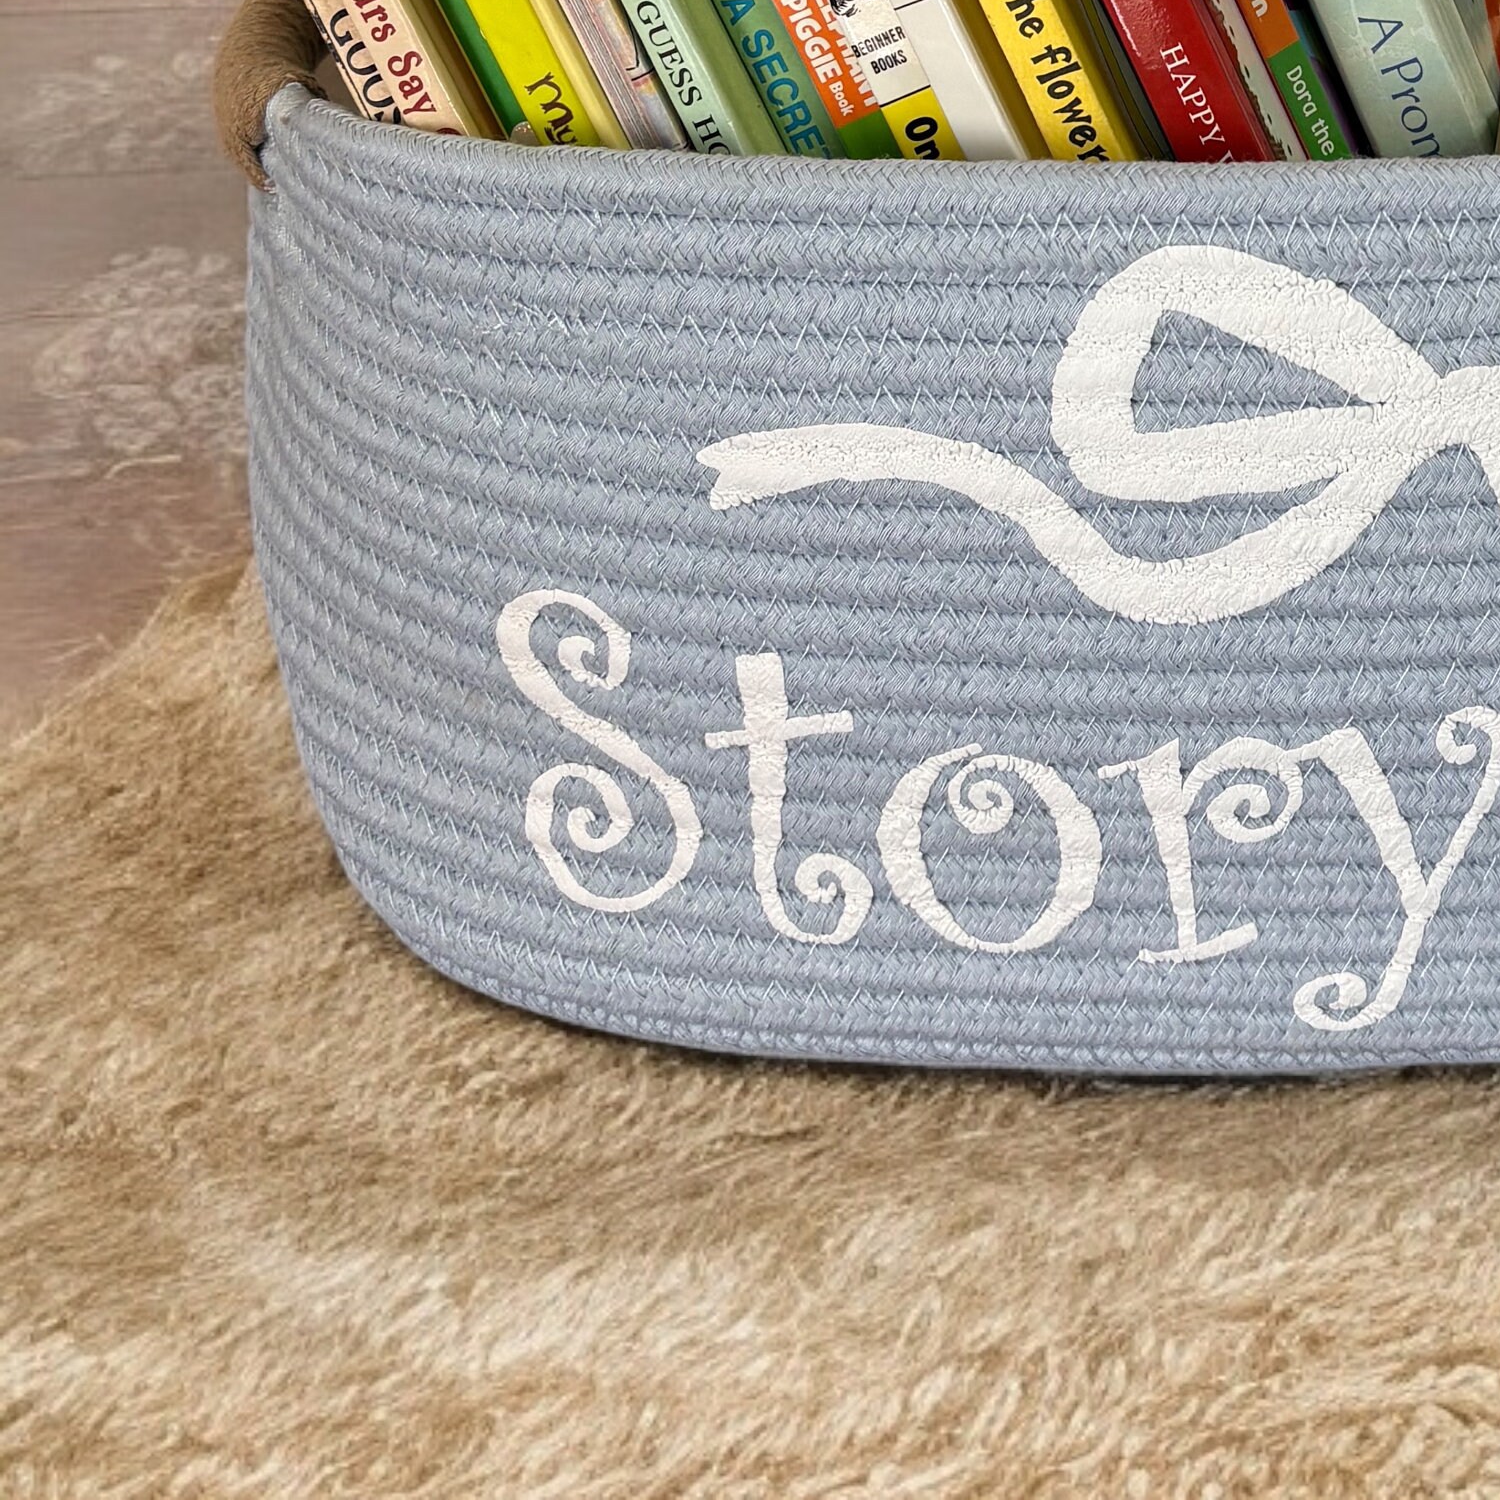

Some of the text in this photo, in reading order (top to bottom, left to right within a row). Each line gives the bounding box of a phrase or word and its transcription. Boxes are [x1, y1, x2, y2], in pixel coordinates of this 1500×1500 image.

[637, 0, 703, 107] GUESS
[851, 26, 906, 58] BEGINNER
[870, 49, 908, 75] BOOKS
[1358, 16, 1404, 54] A
[388, 50, 437, 115] Say
[742, 29, 831, 159] SECRE
[828, 80, 855, 117] Book
[1160, 42, 1226, 146] HAPPY
[1286, 65, 1317, 117] Dora
[1310, 117, 1335, 156] the
